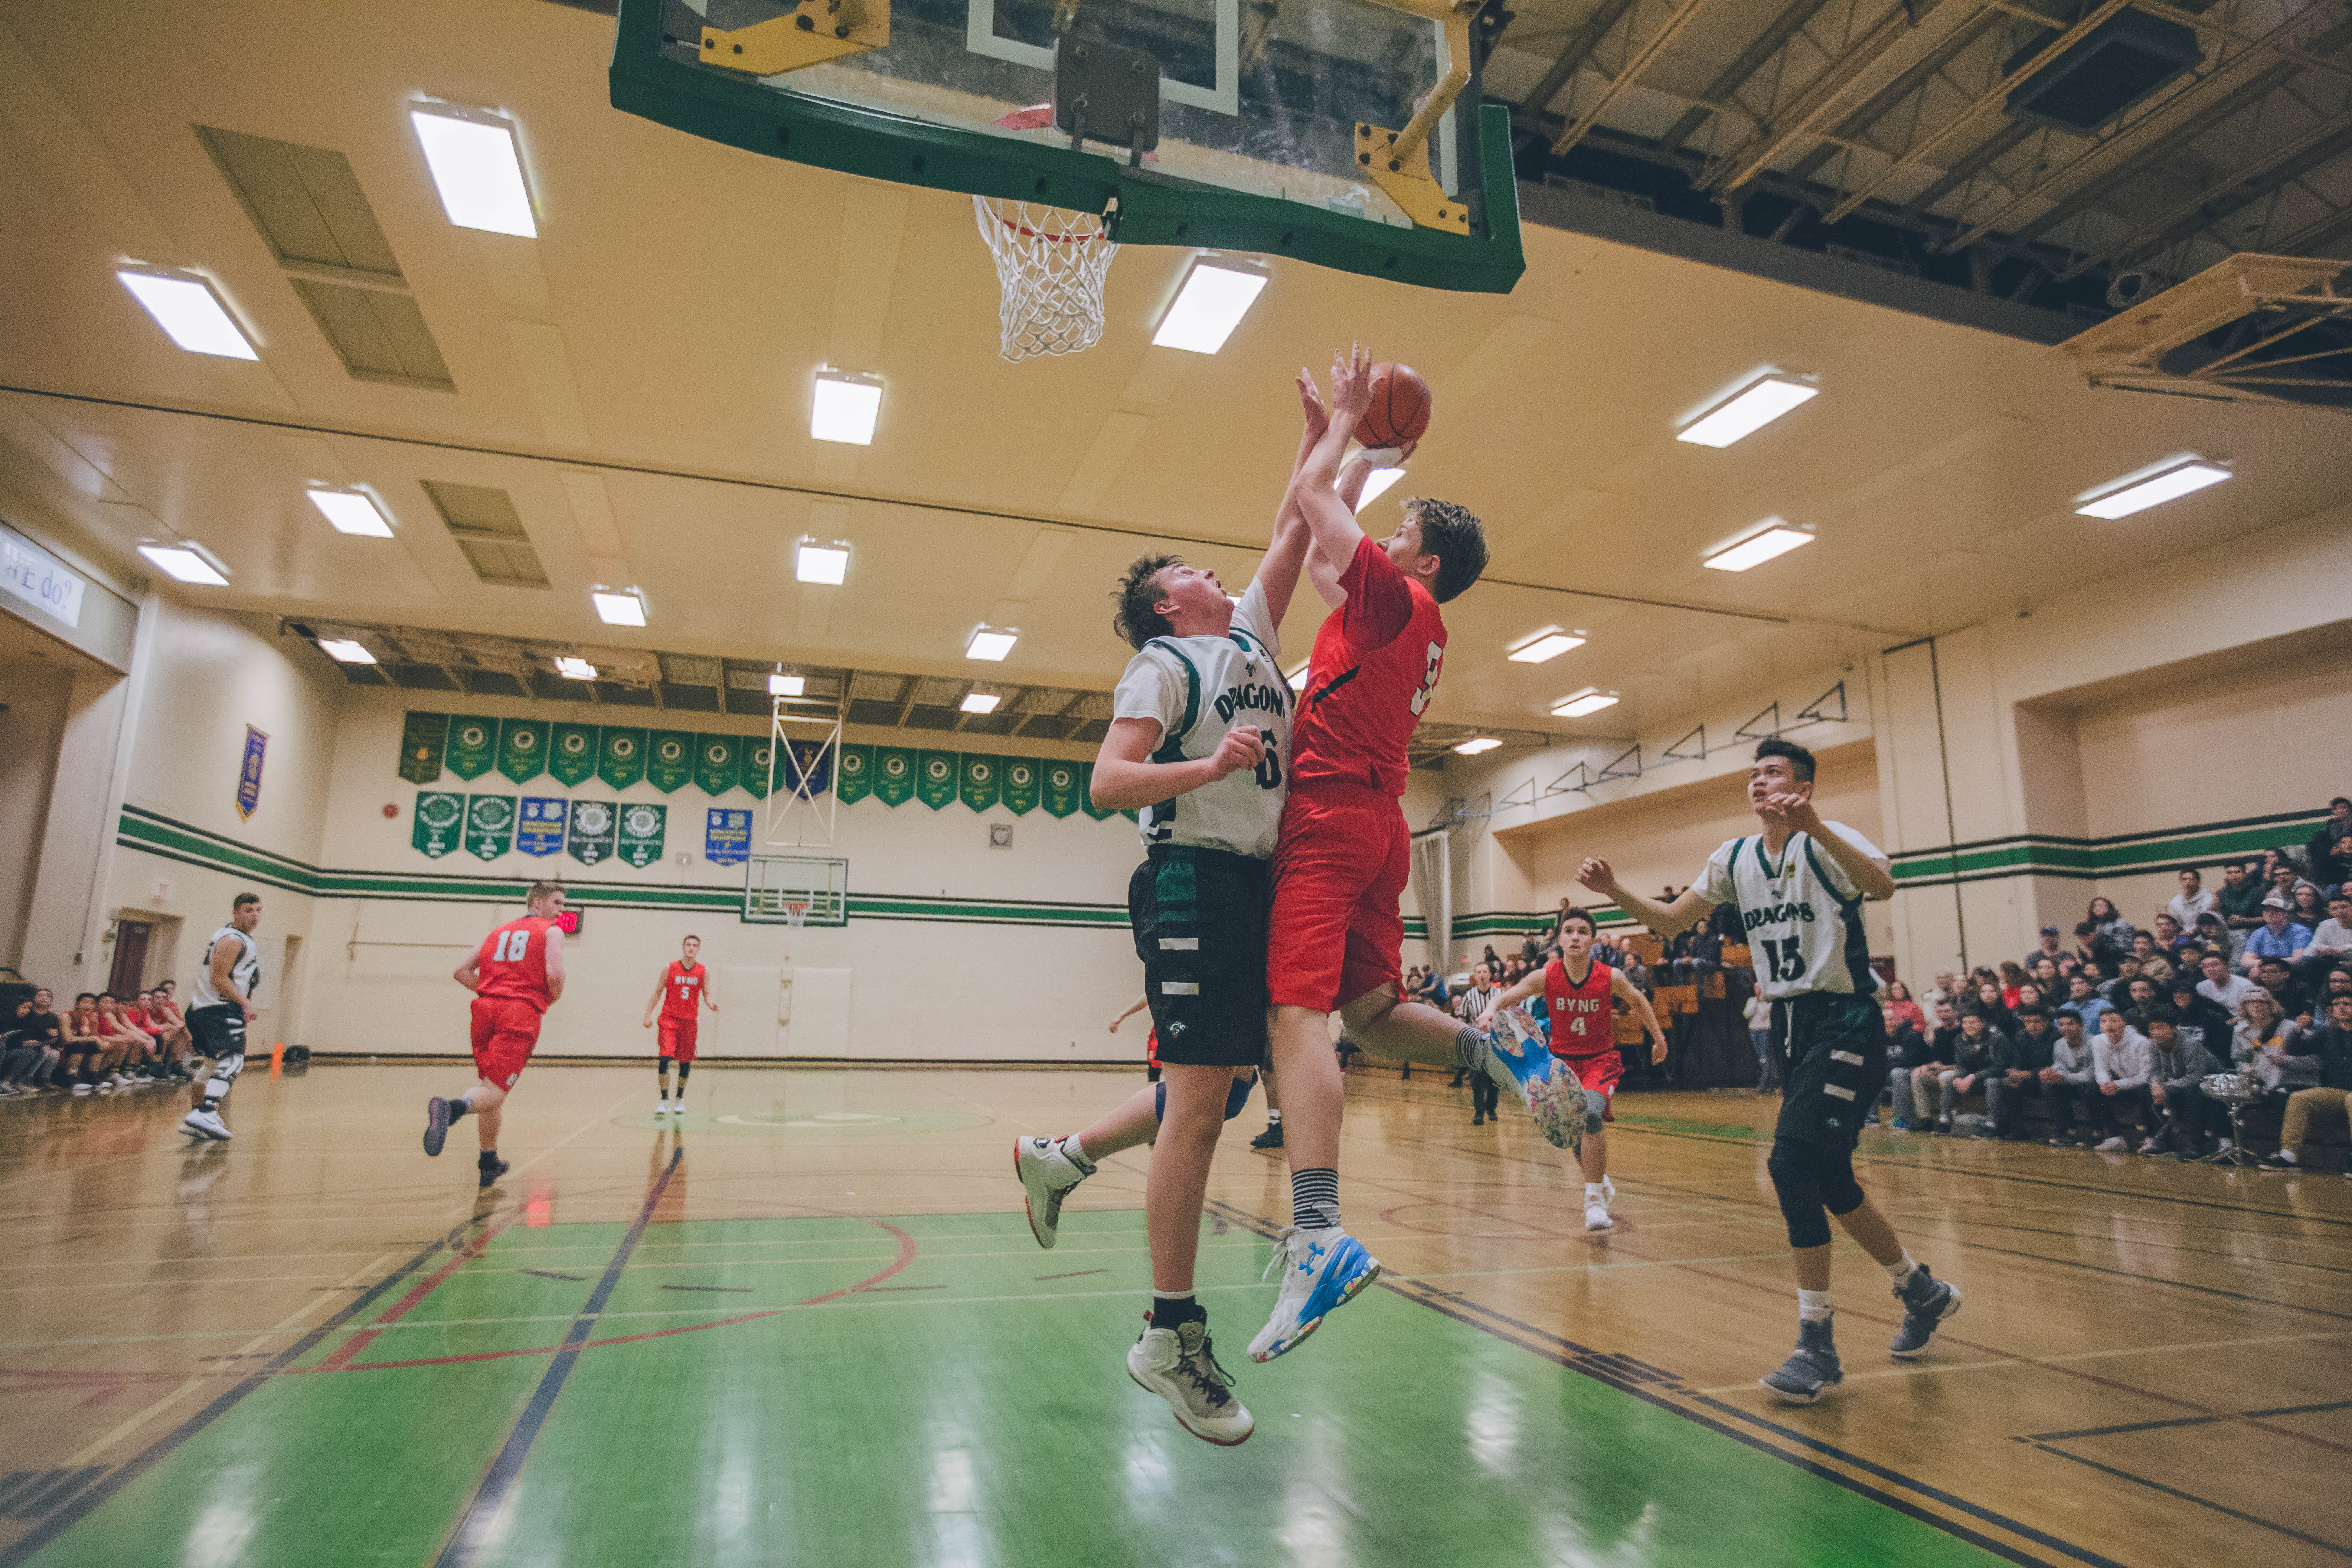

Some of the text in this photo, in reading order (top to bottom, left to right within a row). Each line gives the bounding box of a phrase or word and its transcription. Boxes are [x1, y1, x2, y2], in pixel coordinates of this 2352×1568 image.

[1214, 683, 1285, 726] DRAGON
[493, 929, 530, 962] 18
[1761, 935, 1806, 982] 15
[681, 986, 690, 1000] 5
[1556, 997, 1599, 1013] BYNG
[1570, 1016, 1587, 1036] 4
